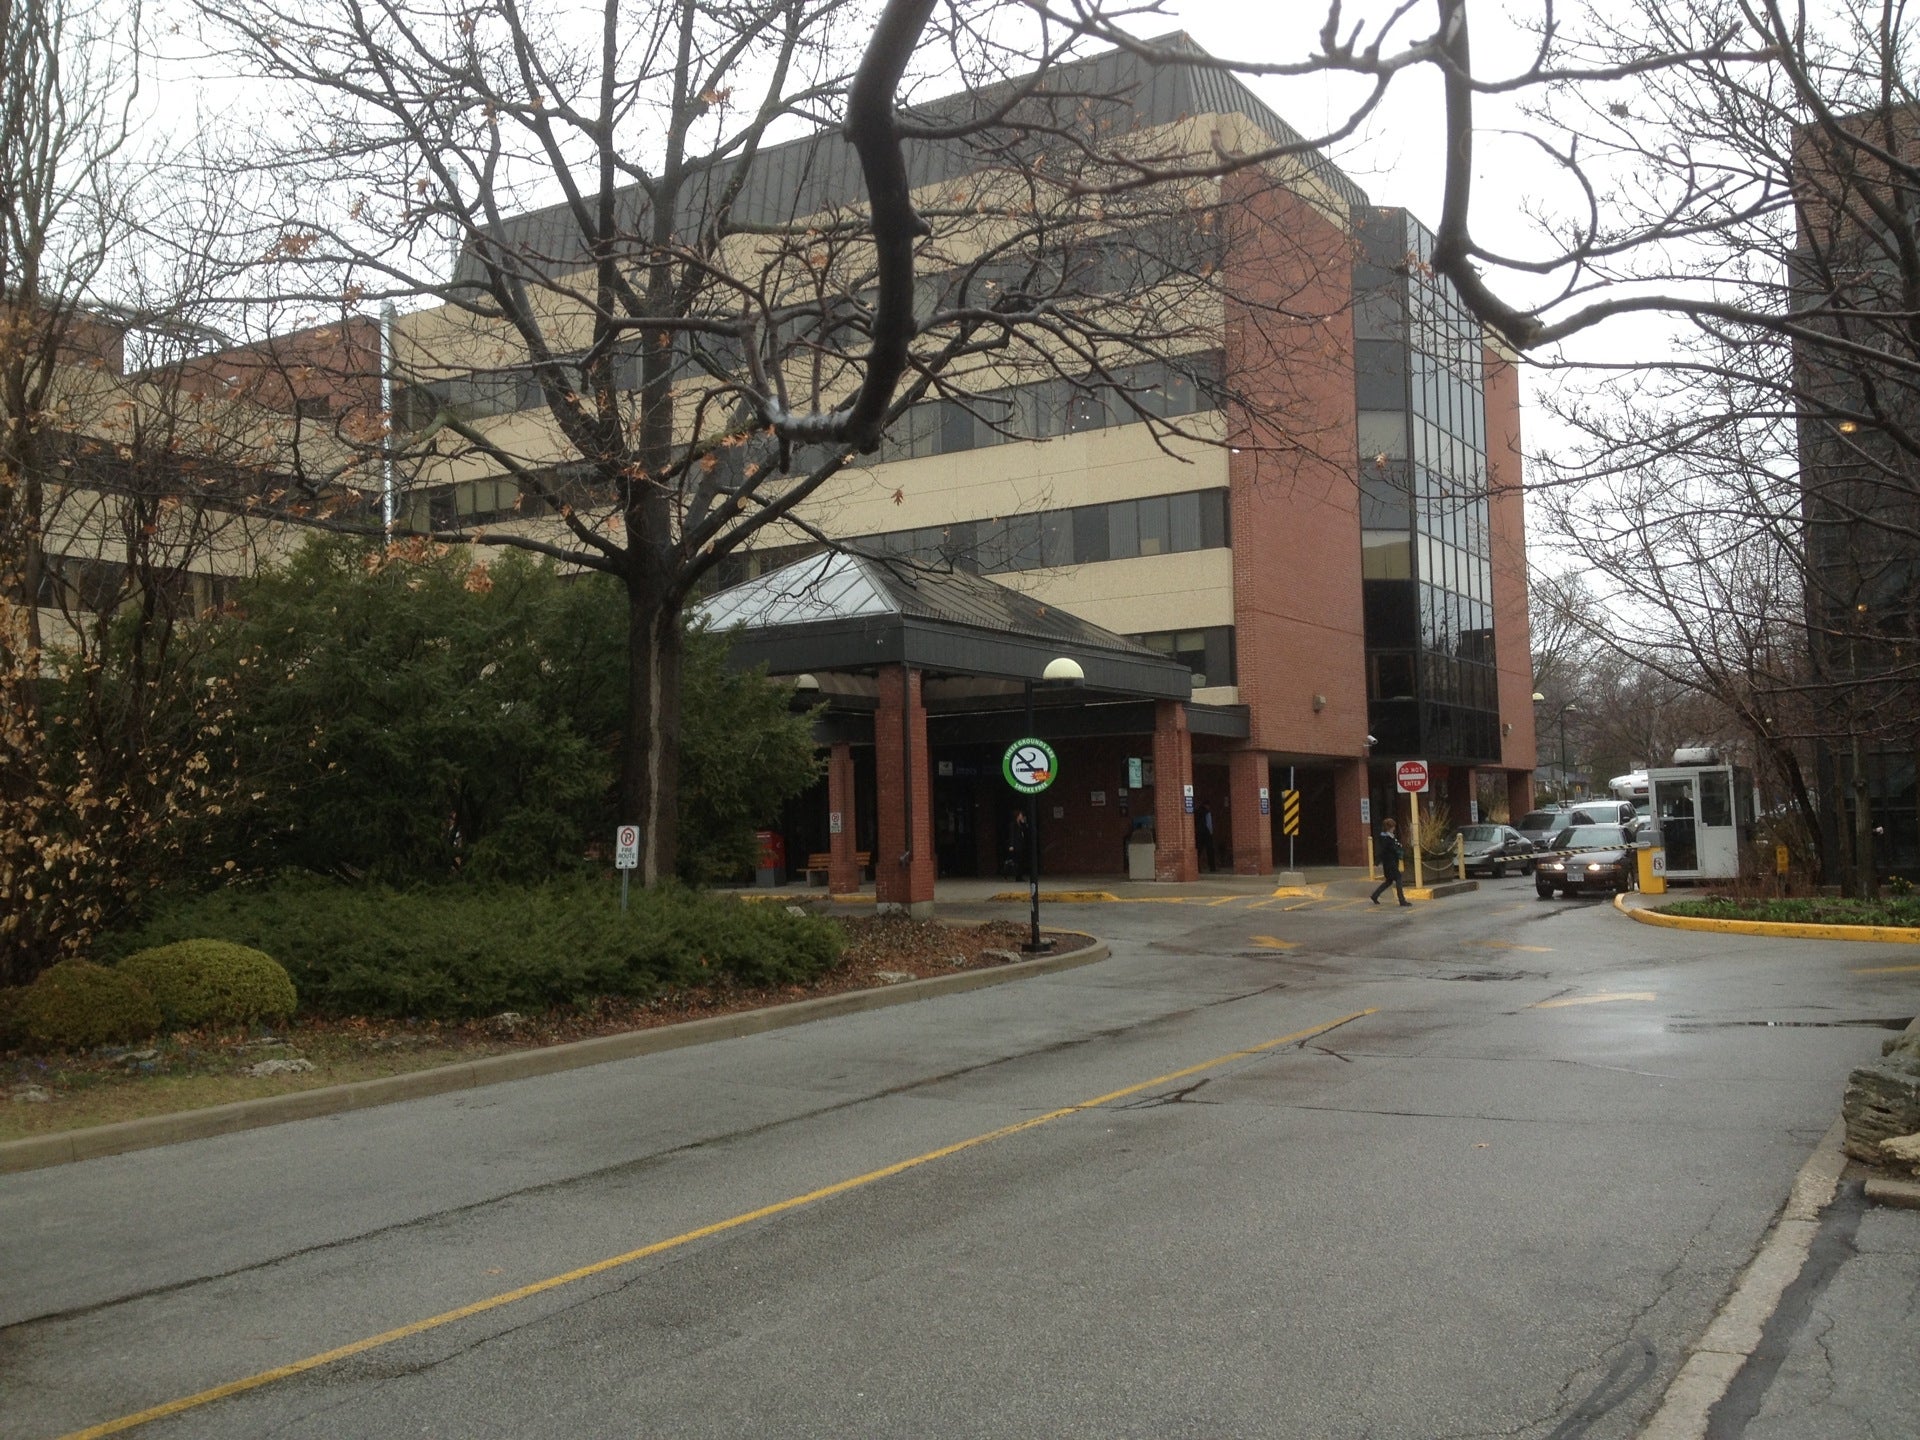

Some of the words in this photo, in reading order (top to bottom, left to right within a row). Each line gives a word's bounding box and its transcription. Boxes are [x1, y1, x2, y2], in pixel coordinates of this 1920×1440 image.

[1005, 743, 1018, 760] THESE
[1018, 739, 1046, 749] GROUNDS
[1046, 746, 1055, 759] ARE
[1015, 783, 1034, 793] SMOKE
[1035, 782, 1048, 792] FREE
